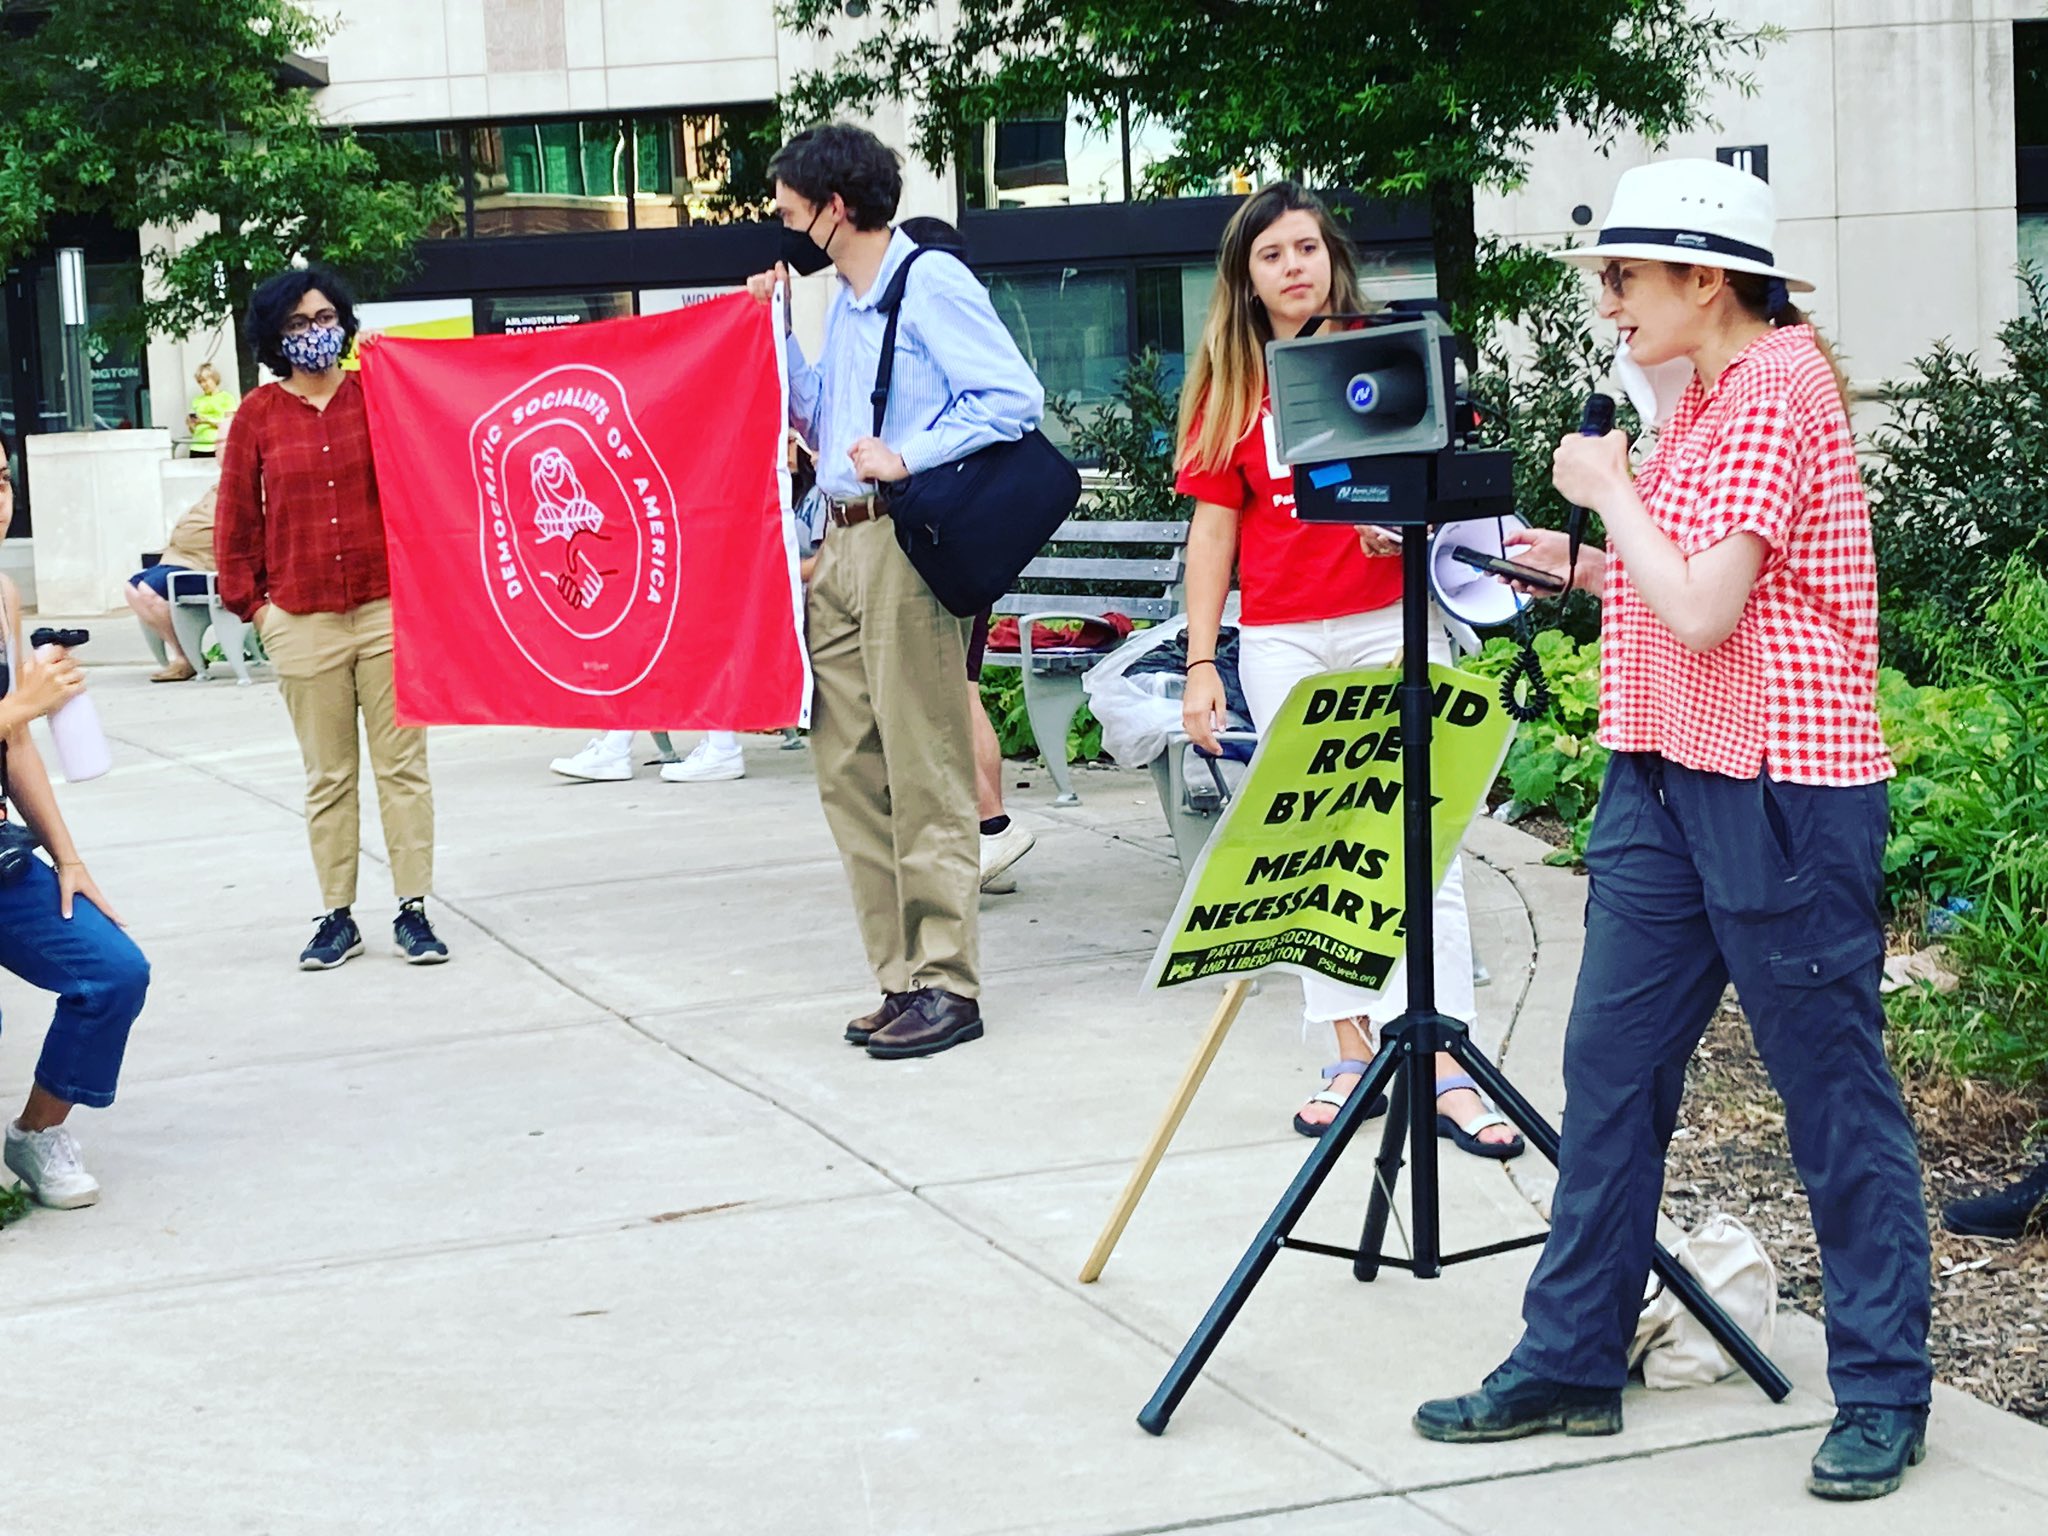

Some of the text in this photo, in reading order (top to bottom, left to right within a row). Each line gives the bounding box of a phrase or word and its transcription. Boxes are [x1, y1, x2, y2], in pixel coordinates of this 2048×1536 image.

[481, 387, 666, 604] DEMOCRATIC SOCIALISTS OF AMERICA
[1264, 777, 1443, 824] BY AN
[1245, 839, 1390, 885] MEANS
[1197, 946, 1307, 977] AND LIBERATION
[1205, 931, 1363, 965] PARTY FOR SOCIALISM
[1317, 956, 1377, 986] PSLweb.org
